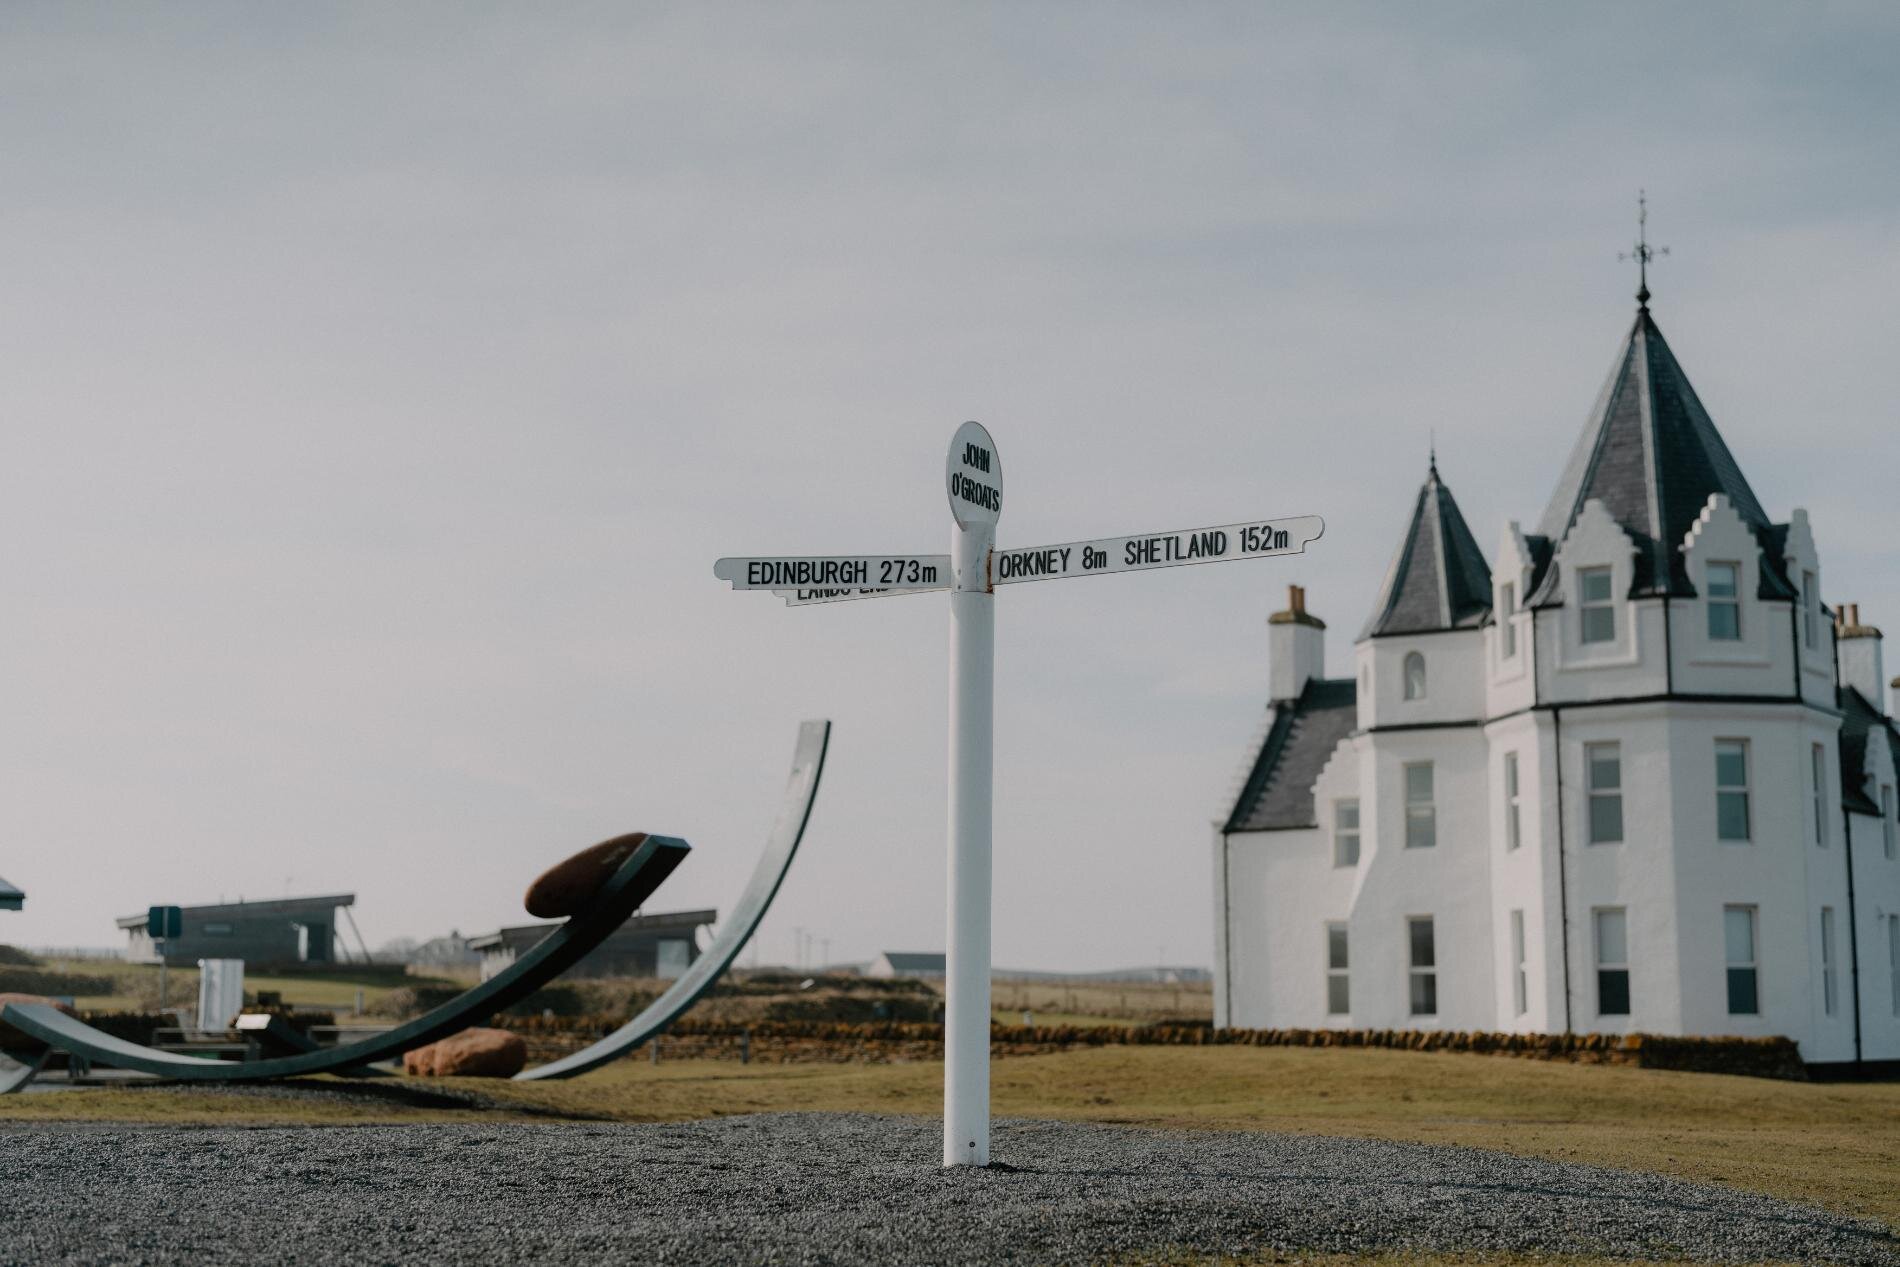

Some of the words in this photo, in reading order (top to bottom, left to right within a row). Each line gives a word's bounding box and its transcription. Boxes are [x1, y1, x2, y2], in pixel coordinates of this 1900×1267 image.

[962, 442, 990, 473] JOHN
[952, 472, 999, 512] O'GROATS
[999, 547, 1071, 578] ORKNEY
[1082, 546, 1107, 569] 8m
[1124, 531, 1227, 566] SHETLAND
[1239, 525, 1288, 553] 152m
[748, 560, 867, 585] EDINBURGH
[880, 560, 937, 583] 273m
